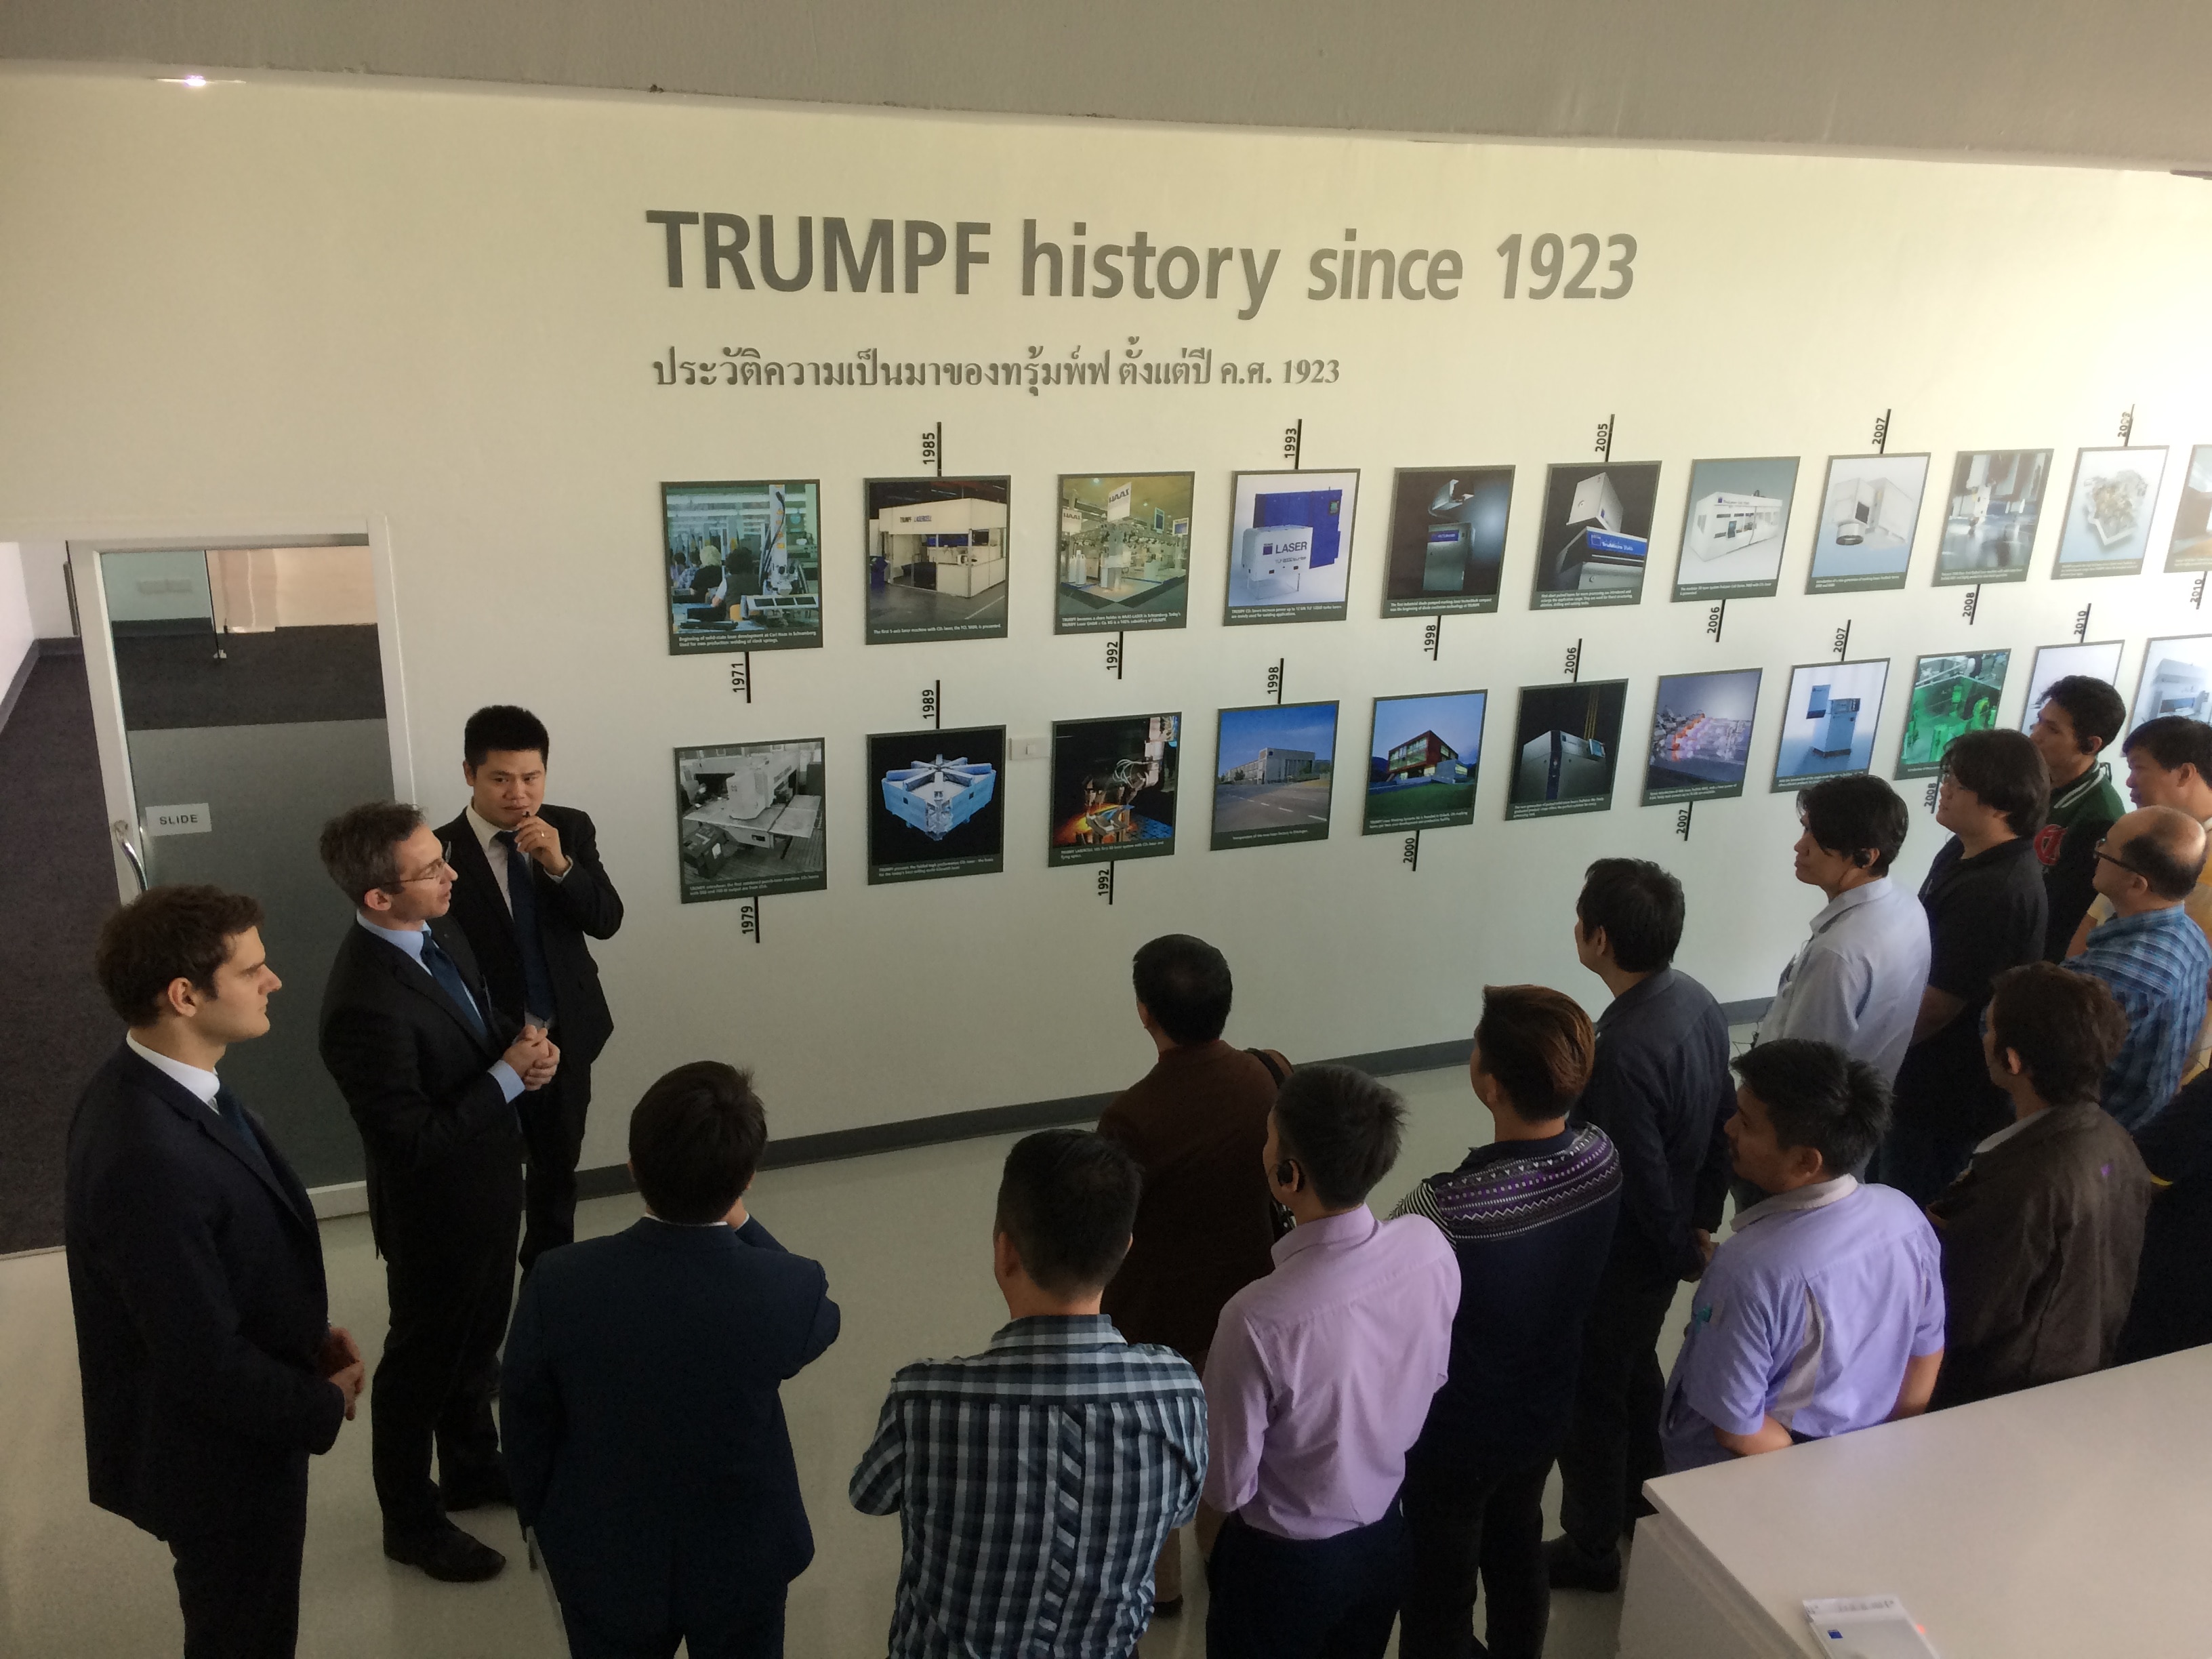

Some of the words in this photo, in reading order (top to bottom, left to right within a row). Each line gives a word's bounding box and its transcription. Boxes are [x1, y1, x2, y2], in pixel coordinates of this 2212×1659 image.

[646, 210, 990, 294] TRUMPF
[1022, 219, 1281, 320] history
[1308, 228, 1462, 300] since
[1497, 233, 1637, 300] 1923
[1284, 360, 1339, 384] 1923
[1284, 428, 1297, 459] 1993
[1595, 423, 1608, 453] 2005
[1872, 417, 1885, 445] 2007
[922, 432, 935, 465] 1985
[1275, 541, 1307, 554] LASER
[2190, 579, 2203, 602] 2010
[1962, 592, 1975, 617] 2008
[1707, 607, 1720, 634] 2006
[2074, 611, 2087, 634] 2010
[1424, 624, 1436, 653] 1998
[1832, 628, 1847, 653] 2007
[1106, 640, 1119, 670] 1992
[1564, 647, 1577, 674] 2006
[733, 662, 745, 693] 1971
[1267, 666, 1279, 695] 1998
[922, 689, 934, 720] 1989
[1924, 783, 1936, 806] 2008
[159, 814, 198, 825] SLIDE
[1676, 808, 1688, 835] 2007
[1403, 837, 1415, 864] 2000
[1098, 869, 1109, 897] 1992
[741, 905, 754, 935] 1979
